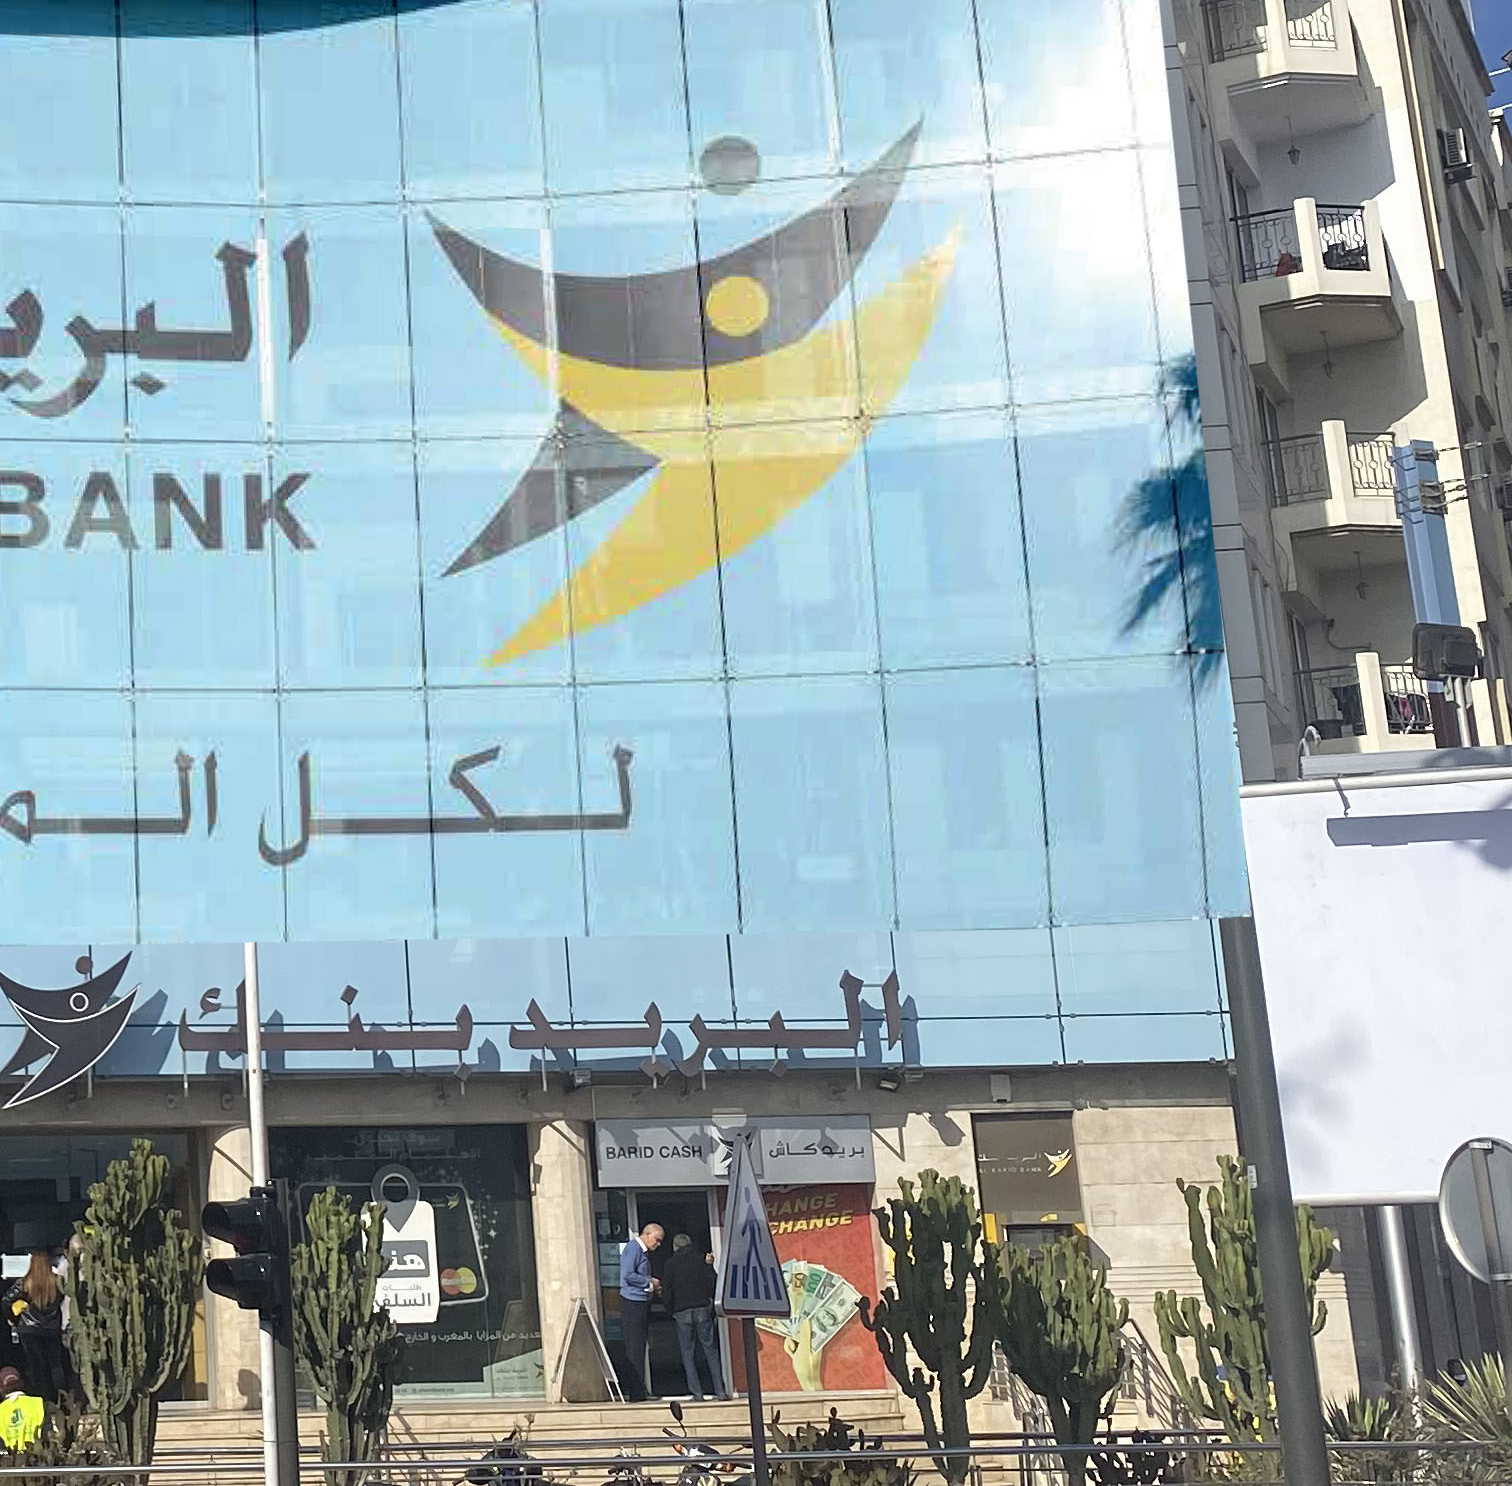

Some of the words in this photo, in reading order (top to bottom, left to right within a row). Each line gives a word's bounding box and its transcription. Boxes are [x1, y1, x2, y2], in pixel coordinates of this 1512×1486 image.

[257, 742, 635, 866] لكل
[179, 978, 473, 1082] بنك
[509, 969, 900, 1080] البريد
[606, 1145, 654, 1160] BARID
[659, 1145, 702, 1159] CASH
[769, 1141, 817, 1158] كاش
[765, 1193, 838, 1215] HANGE
